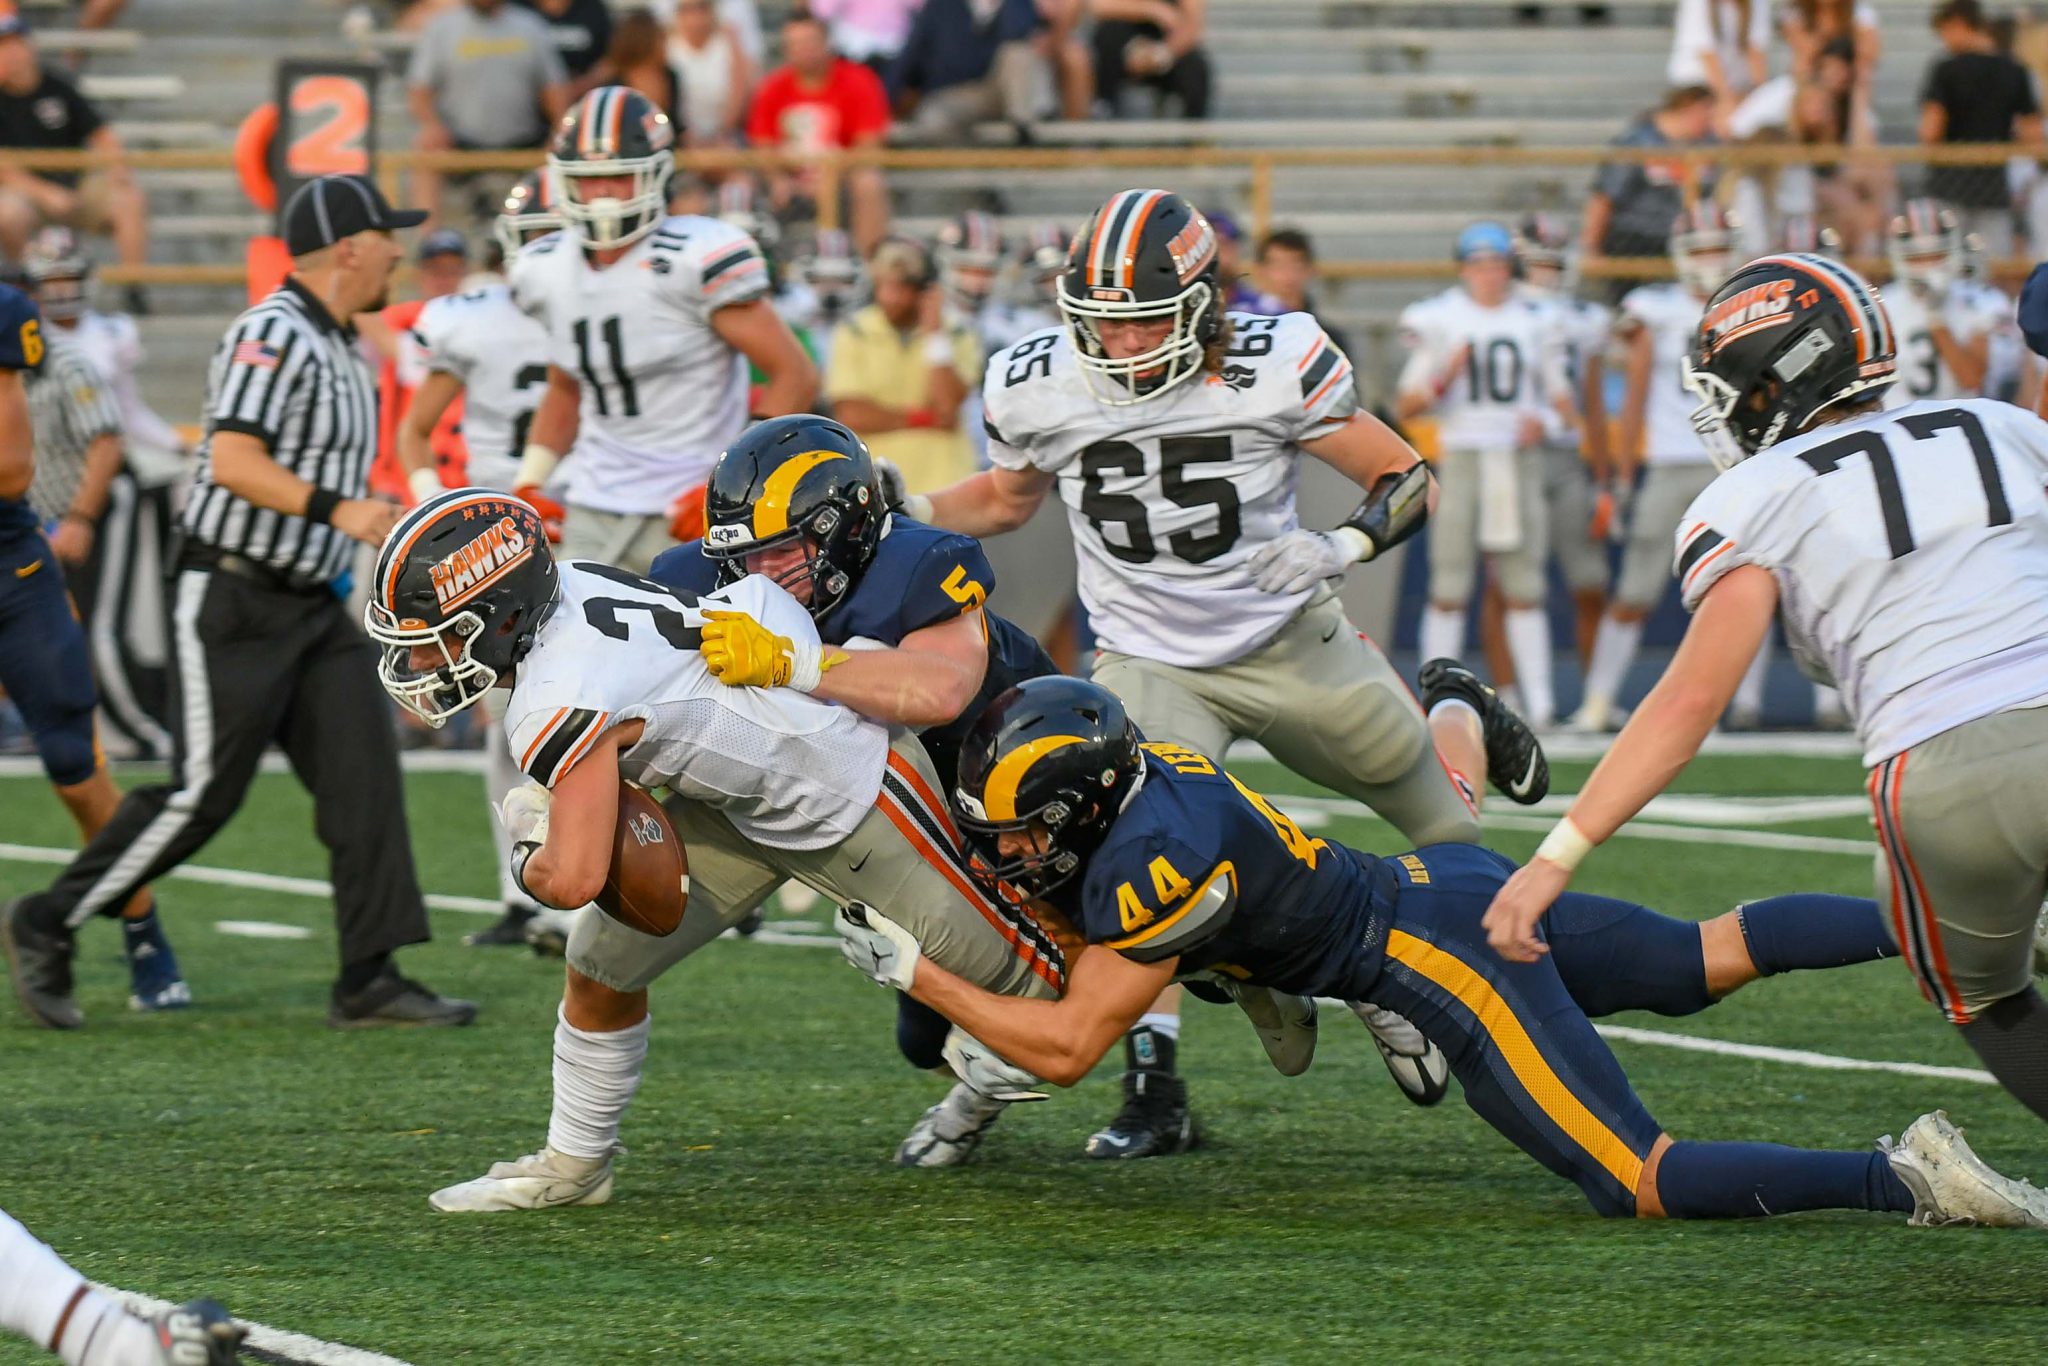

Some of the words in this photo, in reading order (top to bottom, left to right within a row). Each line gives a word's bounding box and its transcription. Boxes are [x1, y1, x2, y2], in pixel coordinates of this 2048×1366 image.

[287, 75, 369, 176] 2
[19, 318, 46, 367] 6
[572, 315, 640, 418] 11
[1004, 334, 1060, 388] 65
[1466, 338, 1521, 403] 10
[1080, 434, 1242, 565] 65
[1794, 407, 2013, 561] 77
[428, 515, 525, 605] HAWKS
[940, 564, 987, 616] 5
[1116, 855, 1193, 933] 44
